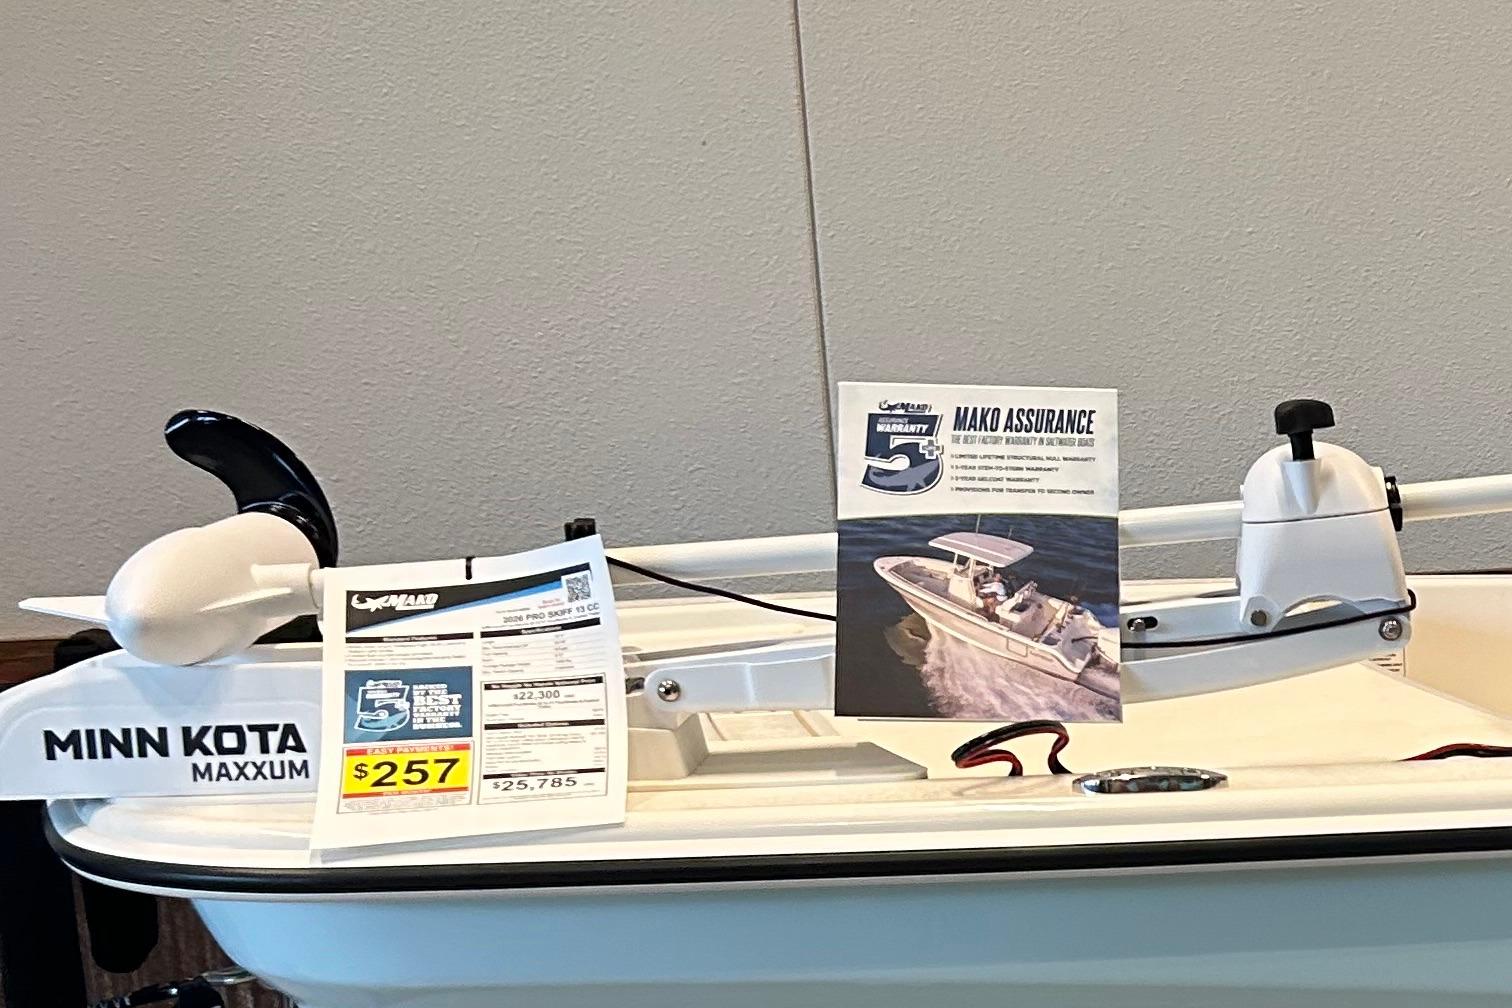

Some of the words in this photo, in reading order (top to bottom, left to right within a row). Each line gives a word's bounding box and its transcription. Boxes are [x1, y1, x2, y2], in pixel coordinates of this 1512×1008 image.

[876, 424, 929, 433] WARRANTY
[953, 407, 1001, 432] MAKO
[1003, 408, 1096, 434] ASSURANCE
[386, 593, 438, 611] MAKO
[526, 612, 546, 620] PRO
[548, 607, 573, 618] SKIFF
[587, 602, 600, 611] CC
[413, 694, 462, 706] BEST
[513, 690, 560, 700] $22,300
[42, 727, 170, 760] MINN
[182, 723, 307, 756] KOTA
[192, 760, 310, 782] MAXXUM
[353, 758, 460, 787] $257
[492, 777, 577, 791] $25,785
